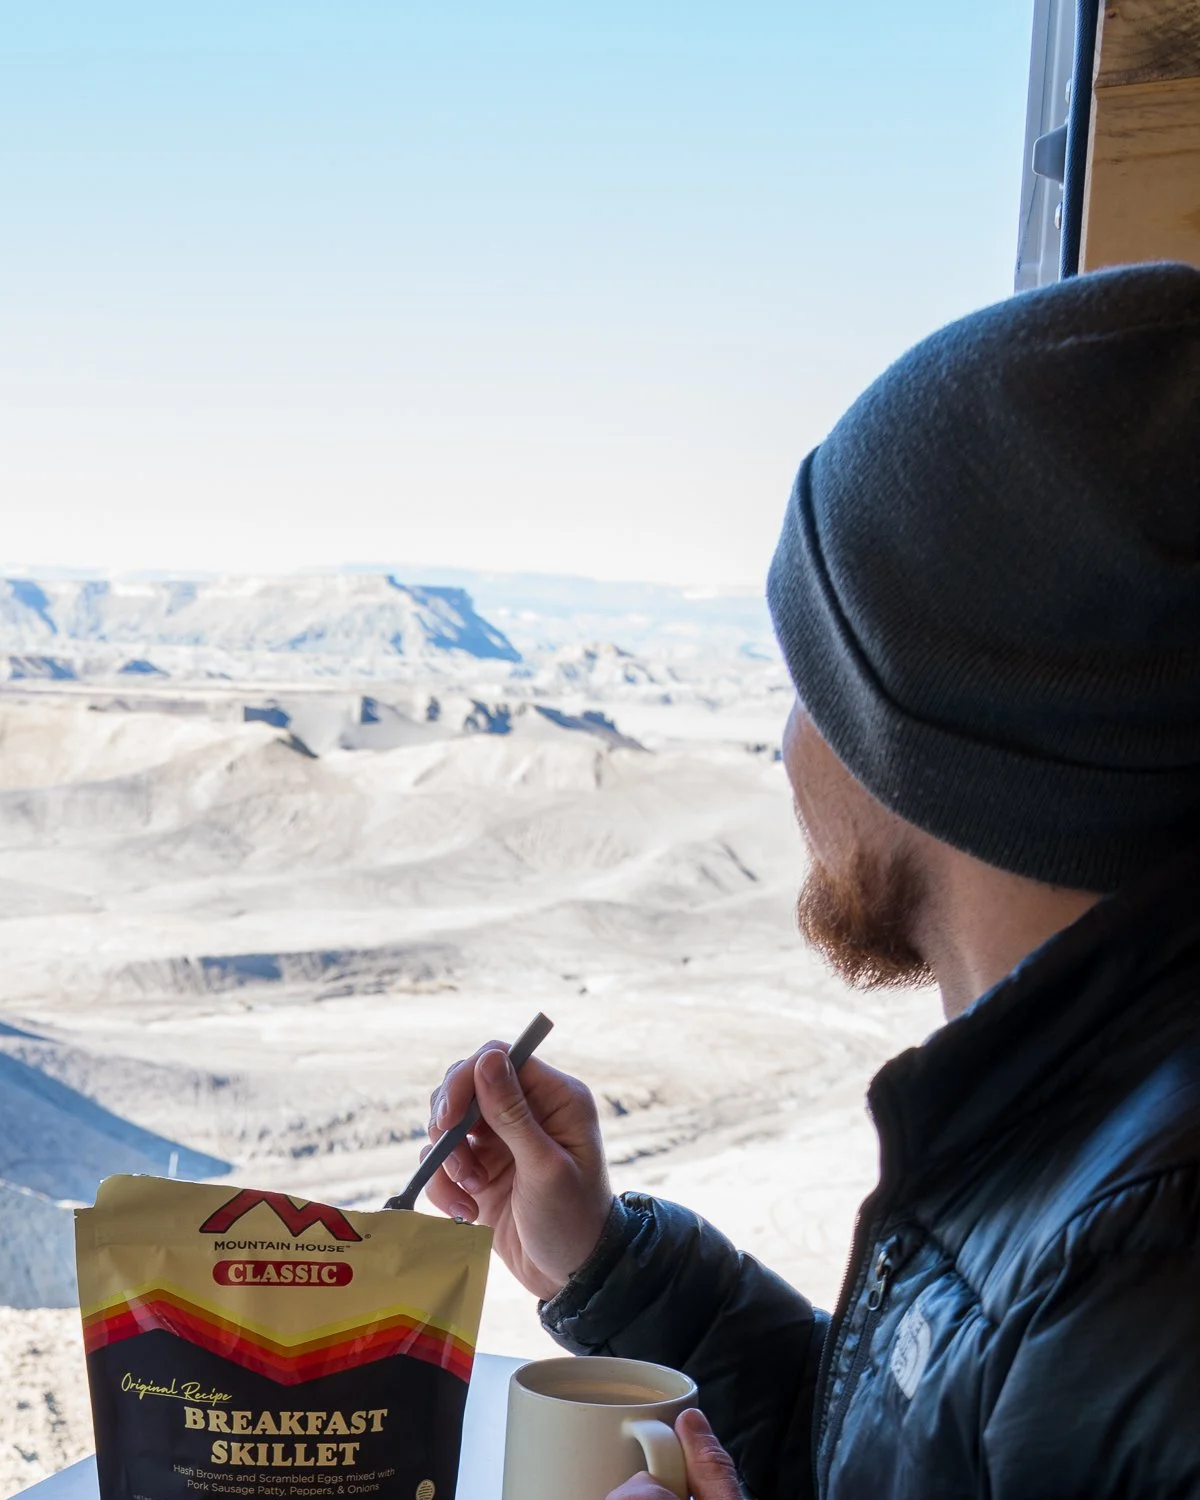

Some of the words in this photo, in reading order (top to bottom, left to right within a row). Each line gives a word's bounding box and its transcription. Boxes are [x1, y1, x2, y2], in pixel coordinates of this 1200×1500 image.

[214, 1240, 291, 1251] MOUNTAIN
[227, 1263, 337, 1284] CLASSIC
[121, 1372, 178, 1400] Original
[181, 1381, 232, 1406] Recipe
[184, 1406, 388, 1435] BREAKFAST
[211, 1440, 360, 1467] SKILLET
[173, 1464, 194, 1476] Hash
[196, 1469, 234, 1481] Browns
[236, 1474, 256, 1482] and
[259, 1473, 314, 1484] Scrambled
[317, 1473, 343, 1484] Eggs
[346, 1471, 376, 1482] mixed
[377, 1467, 395, 1479] with
[187, 1479, 209, 1491] Pork
[211, 1483, 255, 1495] Sausage
[257, 1486, 287, 1497] Patty,
[337, 1485, 345, 1495] &
[347, 1483, 380, 1494] Onions
